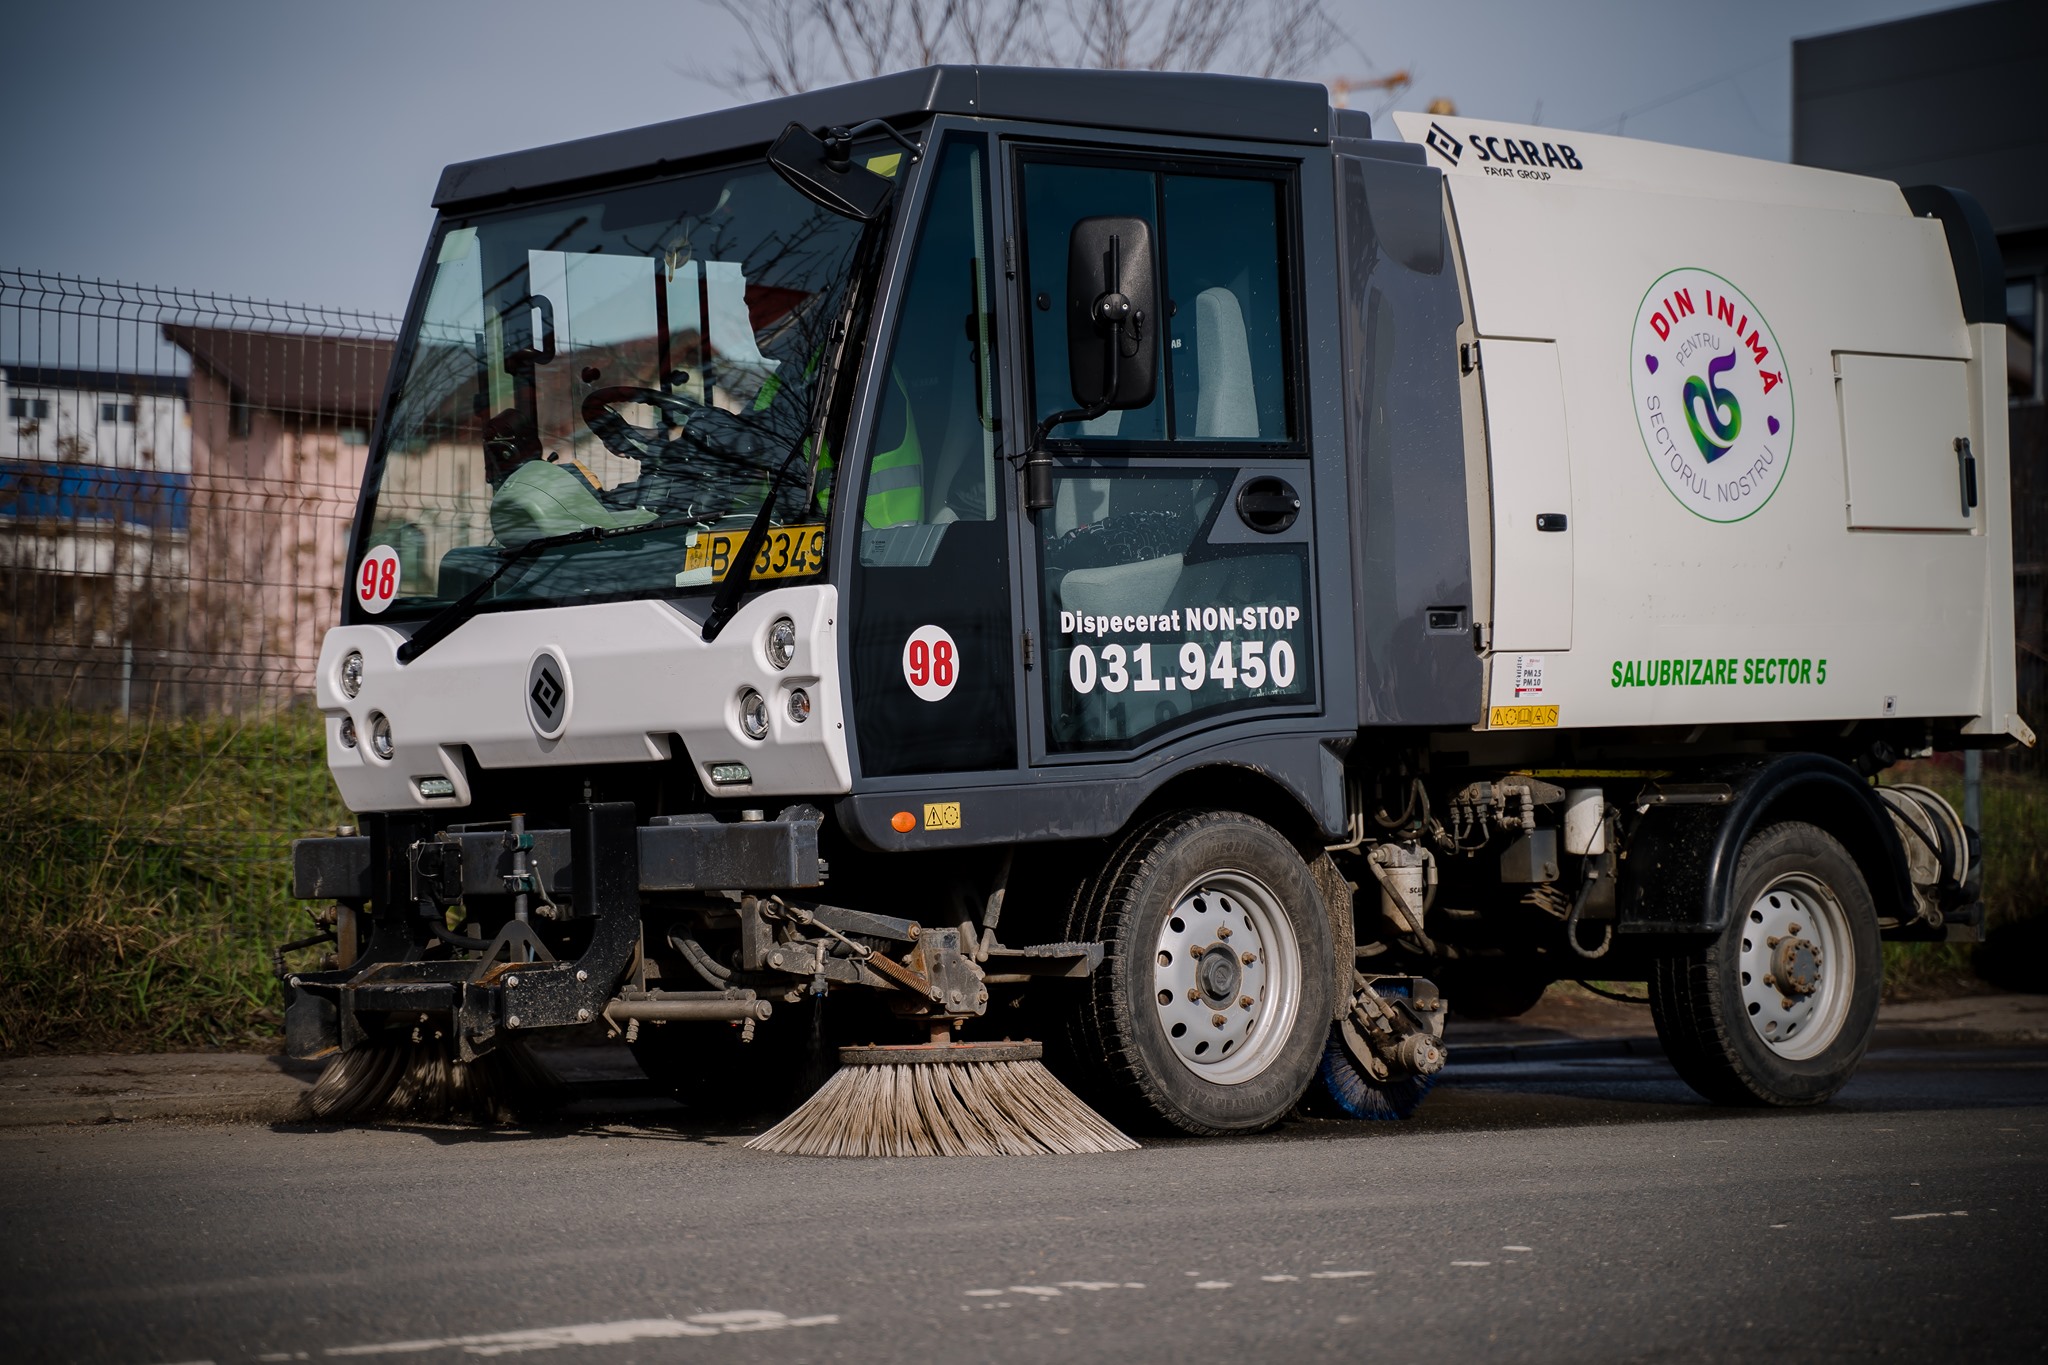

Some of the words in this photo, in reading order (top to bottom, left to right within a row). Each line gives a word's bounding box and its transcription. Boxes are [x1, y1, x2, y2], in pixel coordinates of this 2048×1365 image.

[1468, 134, 1584, 171] SCARAB
[1483, 166, 1514, 178] FAYAT
[1517, 169, 1551, 181] GROUP
[1649, 287, 1695, 342] DIN
[1705, 289, 1783, 395] INIMĂ
[1675, 332, 1720, 367] PENTRU
[1646, 395, 1711, 501] SECTORUL
[1717, 444, 1774, 503] NOSTRU
[712, 536, 732, 577] B
[754, 530, 825, 574] 3349
[361, 557, 396, 600] 98
[1060, 609, 1180, 637] Dispecerat
[1185, 606, 1300, 632] NON-STOP
[909, 639, 953, 686] 98
[1069, 640, 1296, 694] 031.9450
[1524, 669, 1533, 677] PM
[1611, 658, 1738, 688] SALUBRIZARE
[1743, 658, 1812, 685] SECTOR
[1816, 659, 1827, 685] 5
[1523, 678, 1532, 686] PM
[1533, 678, 1541, 686] 10
